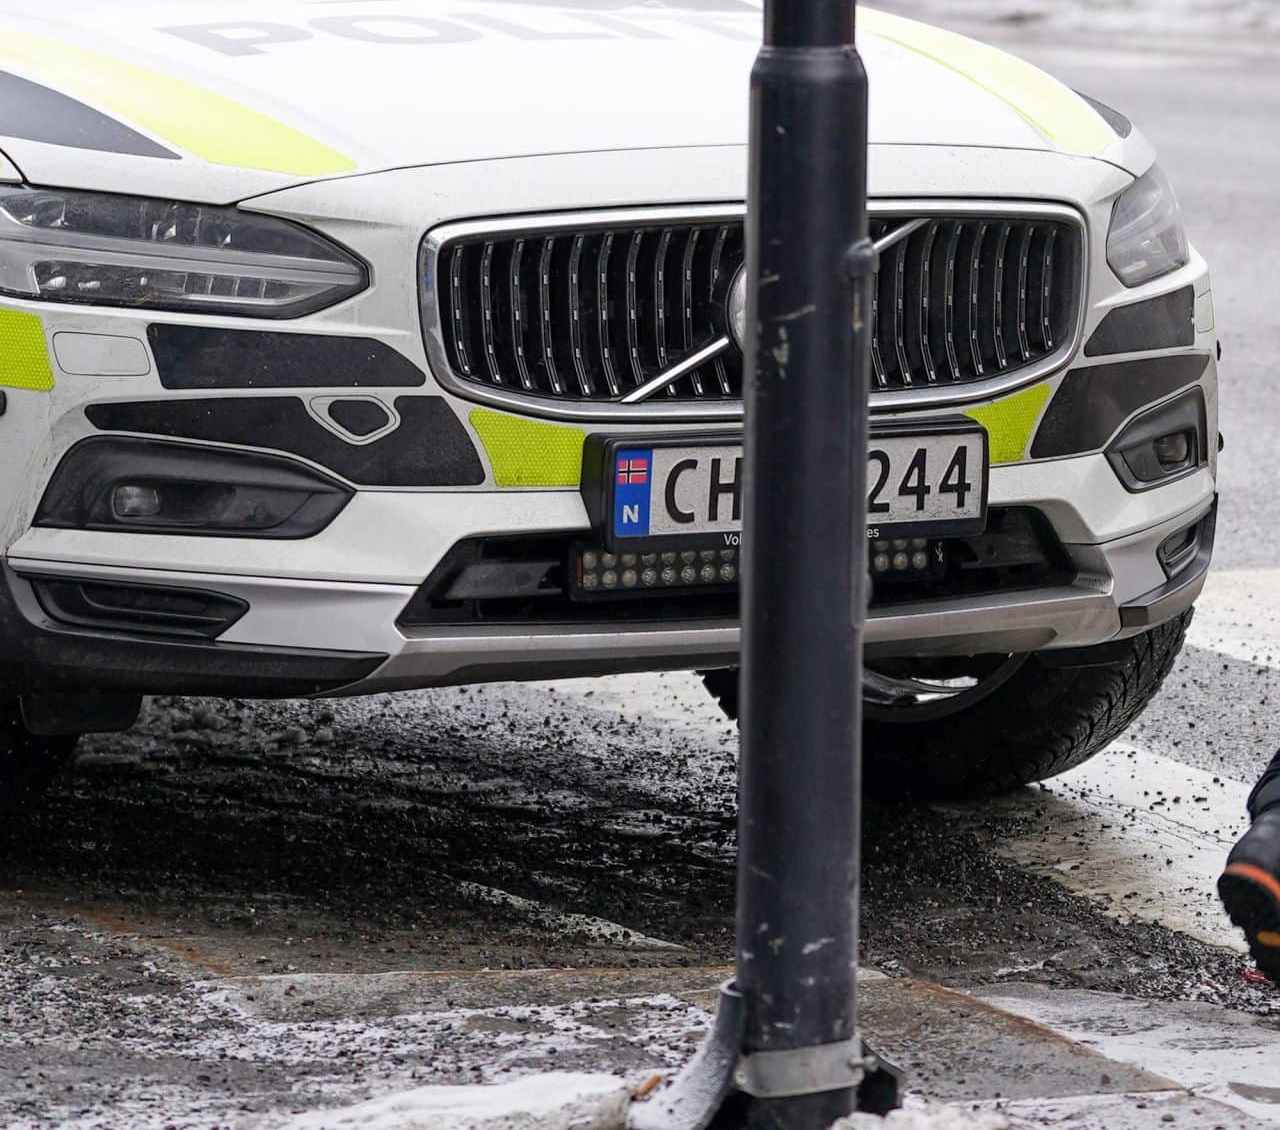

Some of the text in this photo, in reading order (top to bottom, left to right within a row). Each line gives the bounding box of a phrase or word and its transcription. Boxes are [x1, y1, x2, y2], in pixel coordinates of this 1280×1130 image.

[158, 13, 763, 56] POLIT
[622, 505, 639, 524] N
[867, 446, 971, 514] 244
